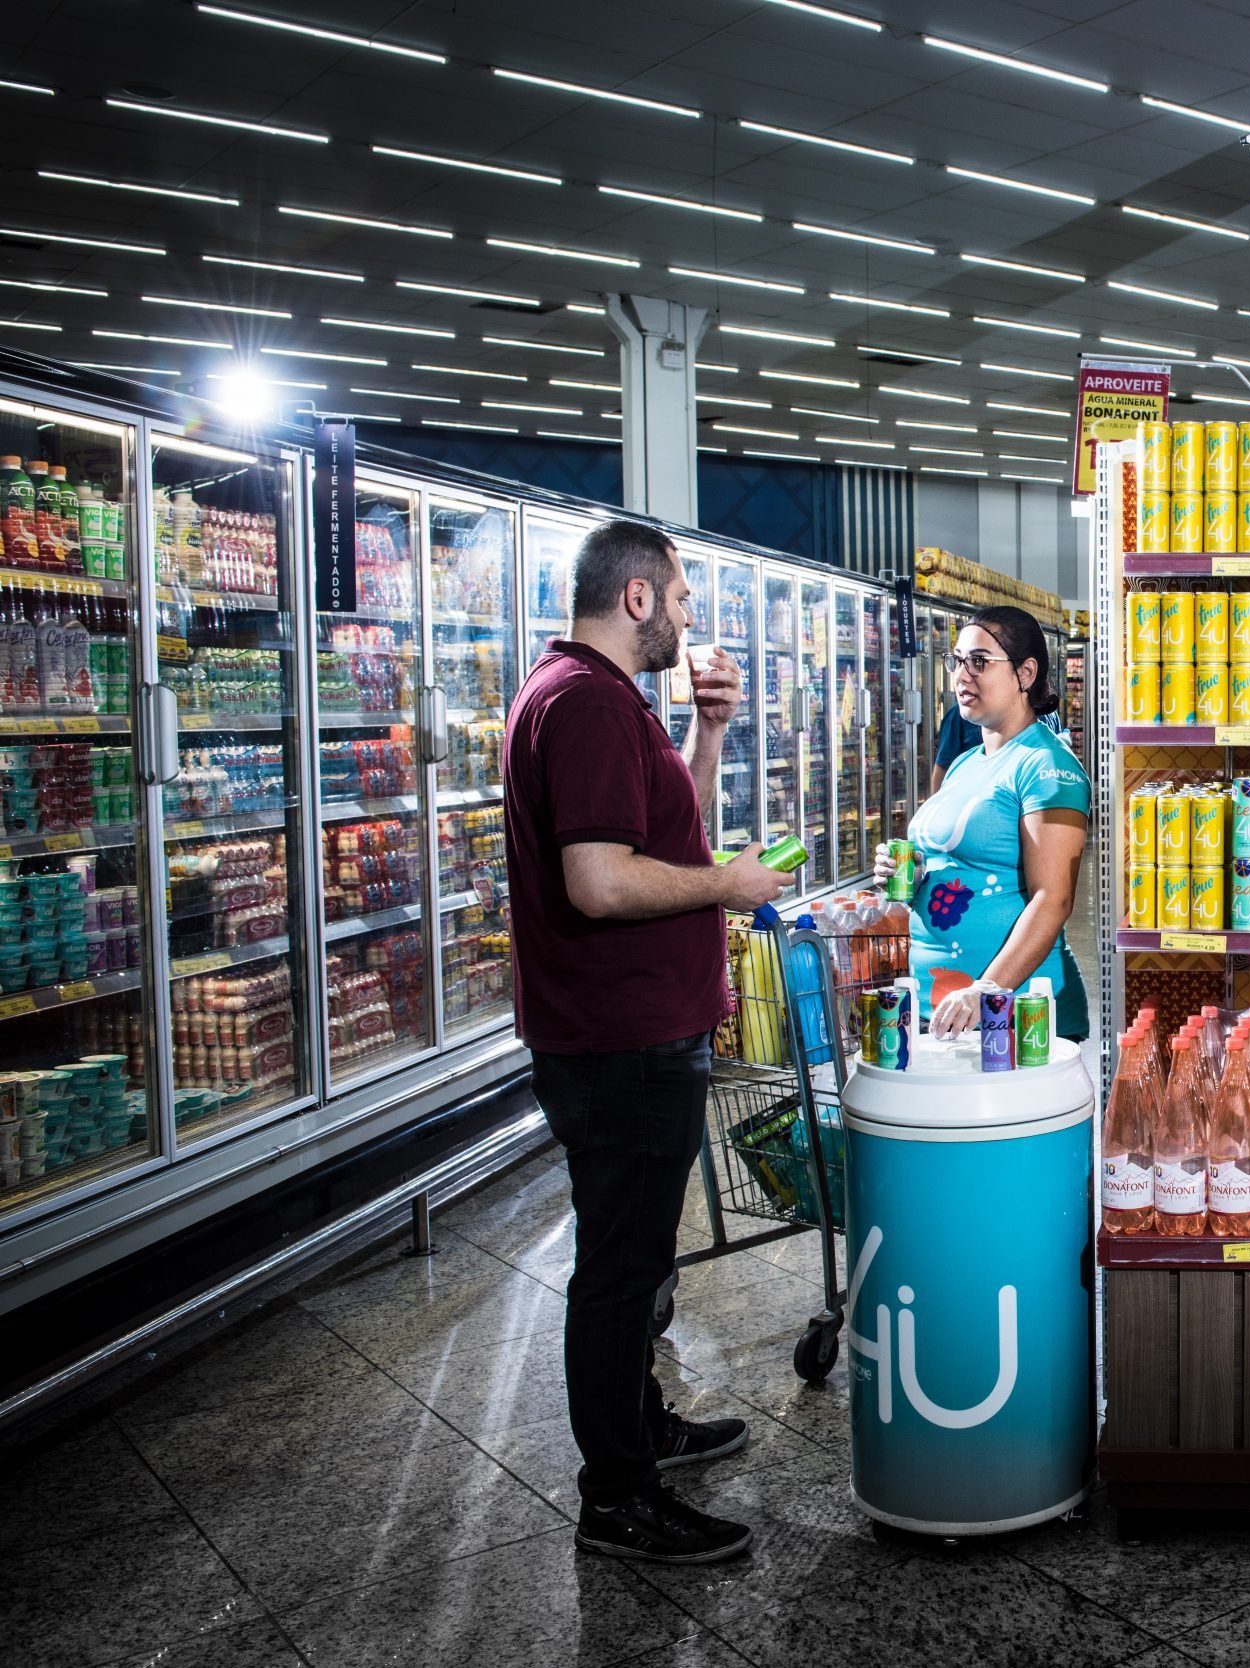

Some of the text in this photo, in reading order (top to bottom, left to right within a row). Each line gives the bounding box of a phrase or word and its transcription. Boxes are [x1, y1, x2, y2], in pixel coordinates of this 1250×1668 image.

[1085, 376, 1162, 392] APROVEITE
[1088, 394, 1157, 408] ÁGUA MINERAL
[1084, 407, 1159, 421] BONAFONT
[9, 486, 35, 496] ACTI
[1173, 501, 1196, 524] true
[1207, 501, 1229, 524] true
[331, 490, 340, 598] FERMENTADO
[902, 594, 910, 644] IOGURTES
[1136, 603, 1159, 625] true
[1198, 603, 1222, 625] true
[1197, 674, 1219, 697] true
[1040, 768, 1084, 783] DANON
[1158, 805, 1179, 829] true
[1193, 805, 1217, 829] true
[1163, 877, 1188, 899] true
[982, 1018, 1008, 1031] tea
[1022, 1007, 1045, 1031] true
[1105, 1163, 1115, 1175] 10
[1210, 1165, 1218, 1178] 10
[1104, 1180, 1149, 1191] BONAFONT
